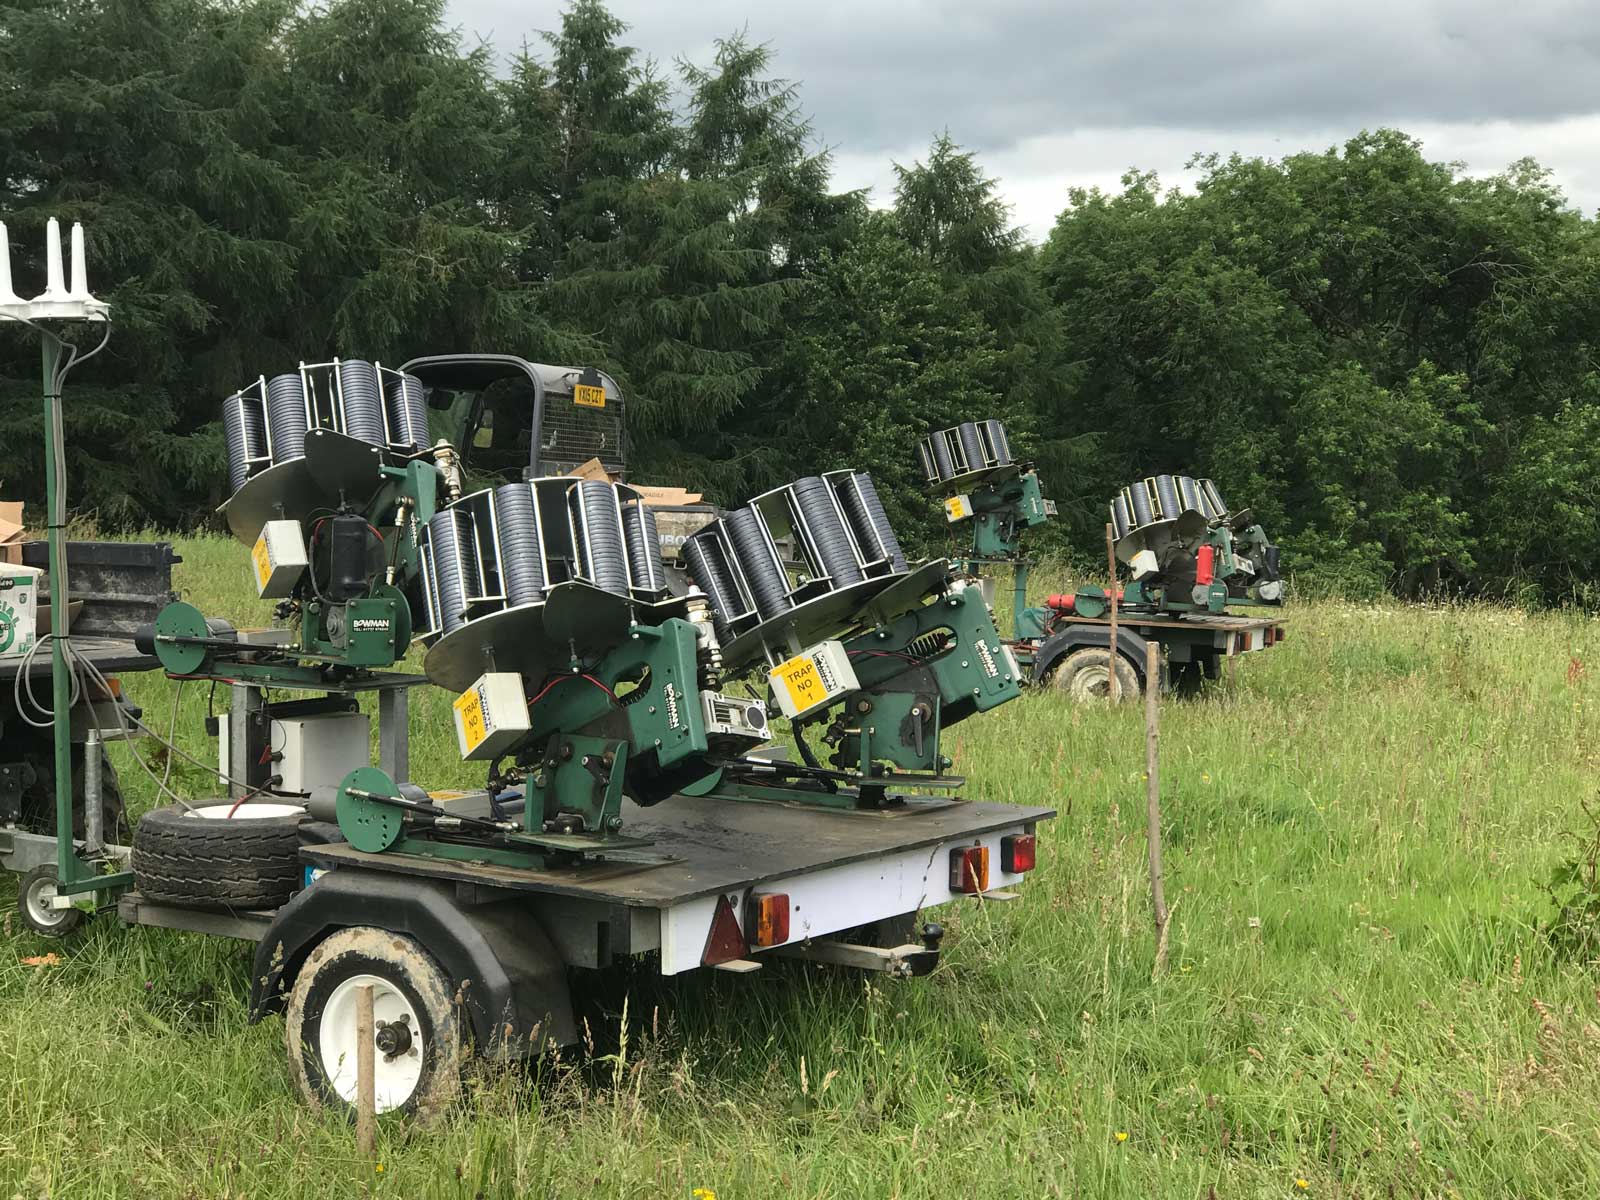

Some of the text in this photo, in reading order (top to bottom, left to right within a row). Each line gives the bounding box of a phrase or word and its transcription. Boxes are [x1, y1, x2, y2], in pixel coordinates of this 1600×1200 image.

[353, 619, 389, 628] BOWMAN
[977, 639, 999, 677] BOWMAN
[787, 663, 813, 683] TRAP
[797, 679, 813, 692] NO
[807, 692, 813, 700] 1
[463, 698, 479, 718] TRAP
[666, 682, 680, 728] BOWMAN
[468, 715, 478, 729] NO
